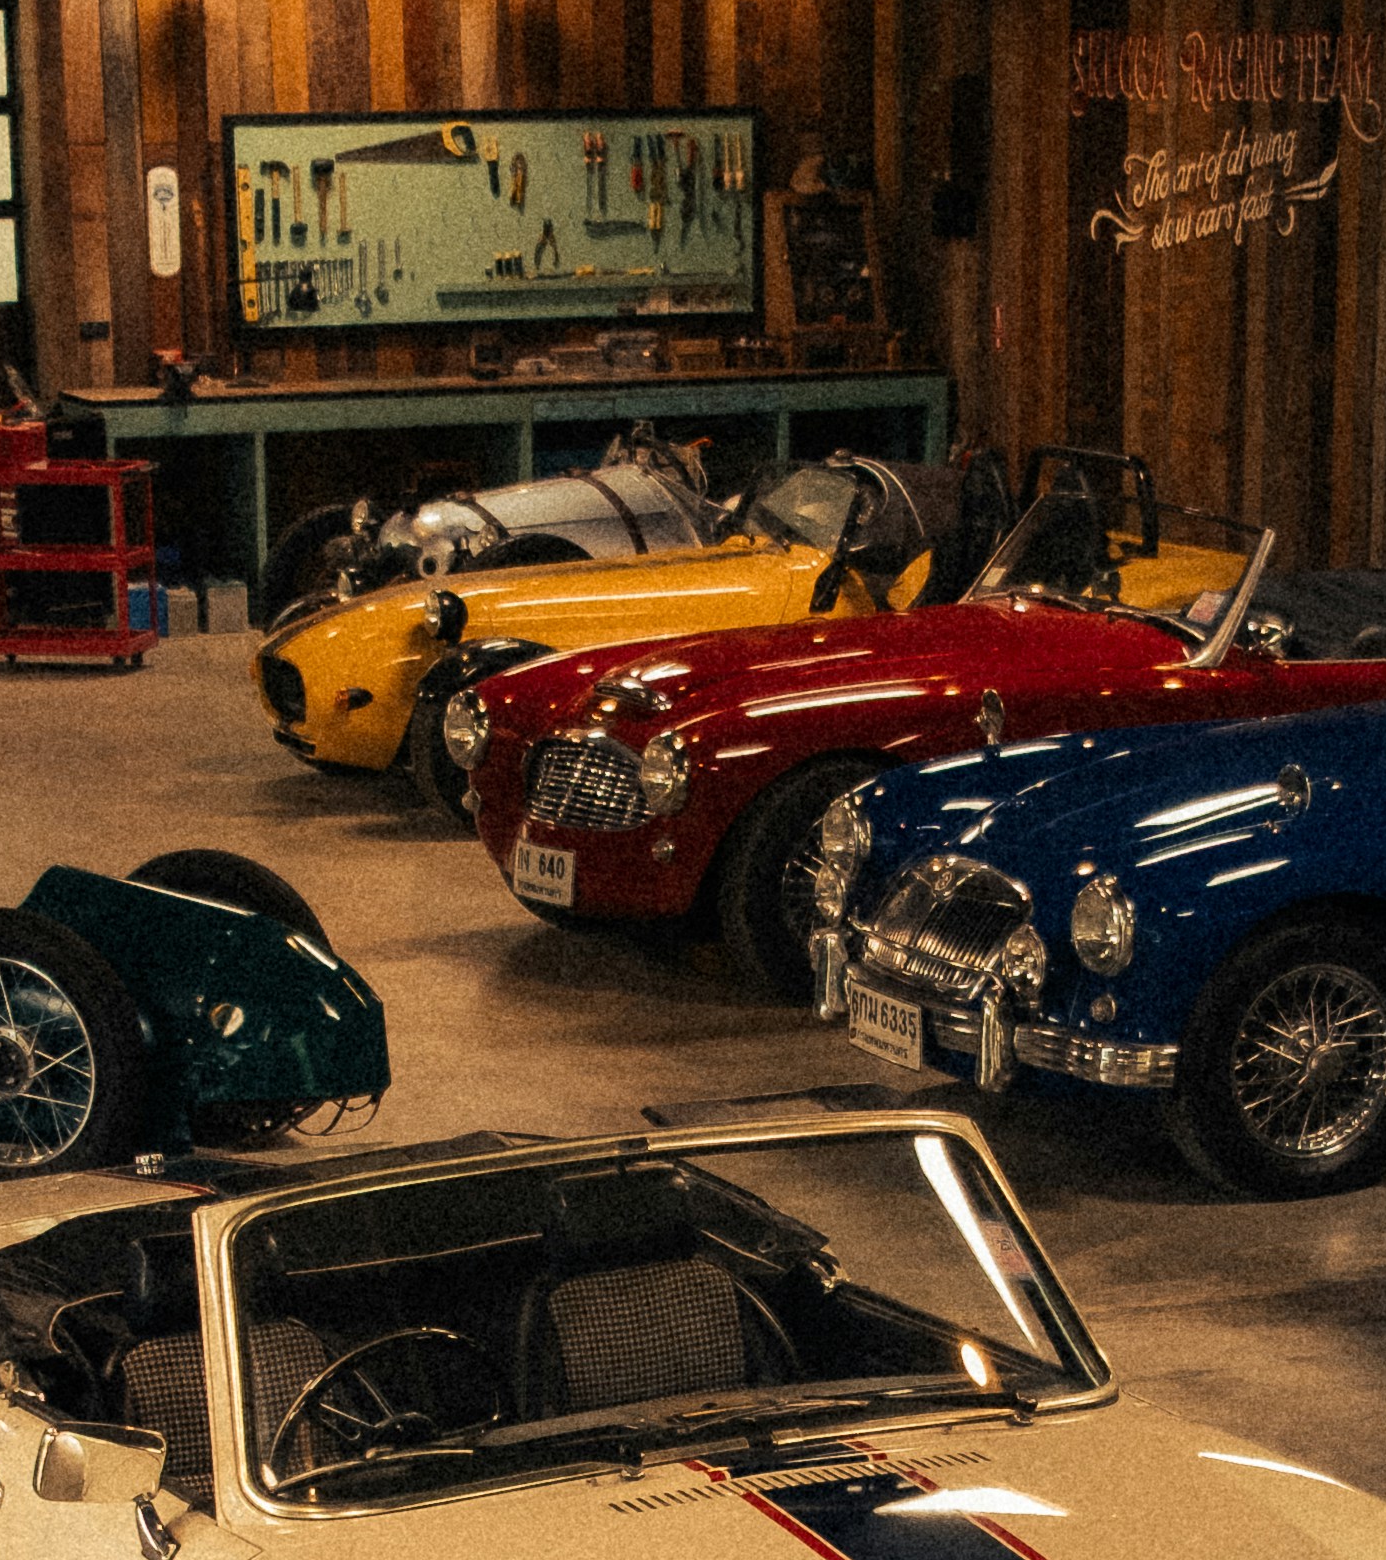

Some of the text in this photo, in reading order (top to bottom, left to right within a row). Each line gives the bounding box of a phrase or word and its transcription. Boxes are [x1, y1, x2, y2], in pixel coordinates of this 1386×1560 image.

[1179, 30, 1285, 112] RACING
[1294, 31, 1385, 143] TEAM
[1123, 126, 1298, 209] The art of driving
[1150, 174, 1275, 251] slow cars fast
[538, 853, 566, 881] 640
[880, 1002, 917, 1040] 6335
